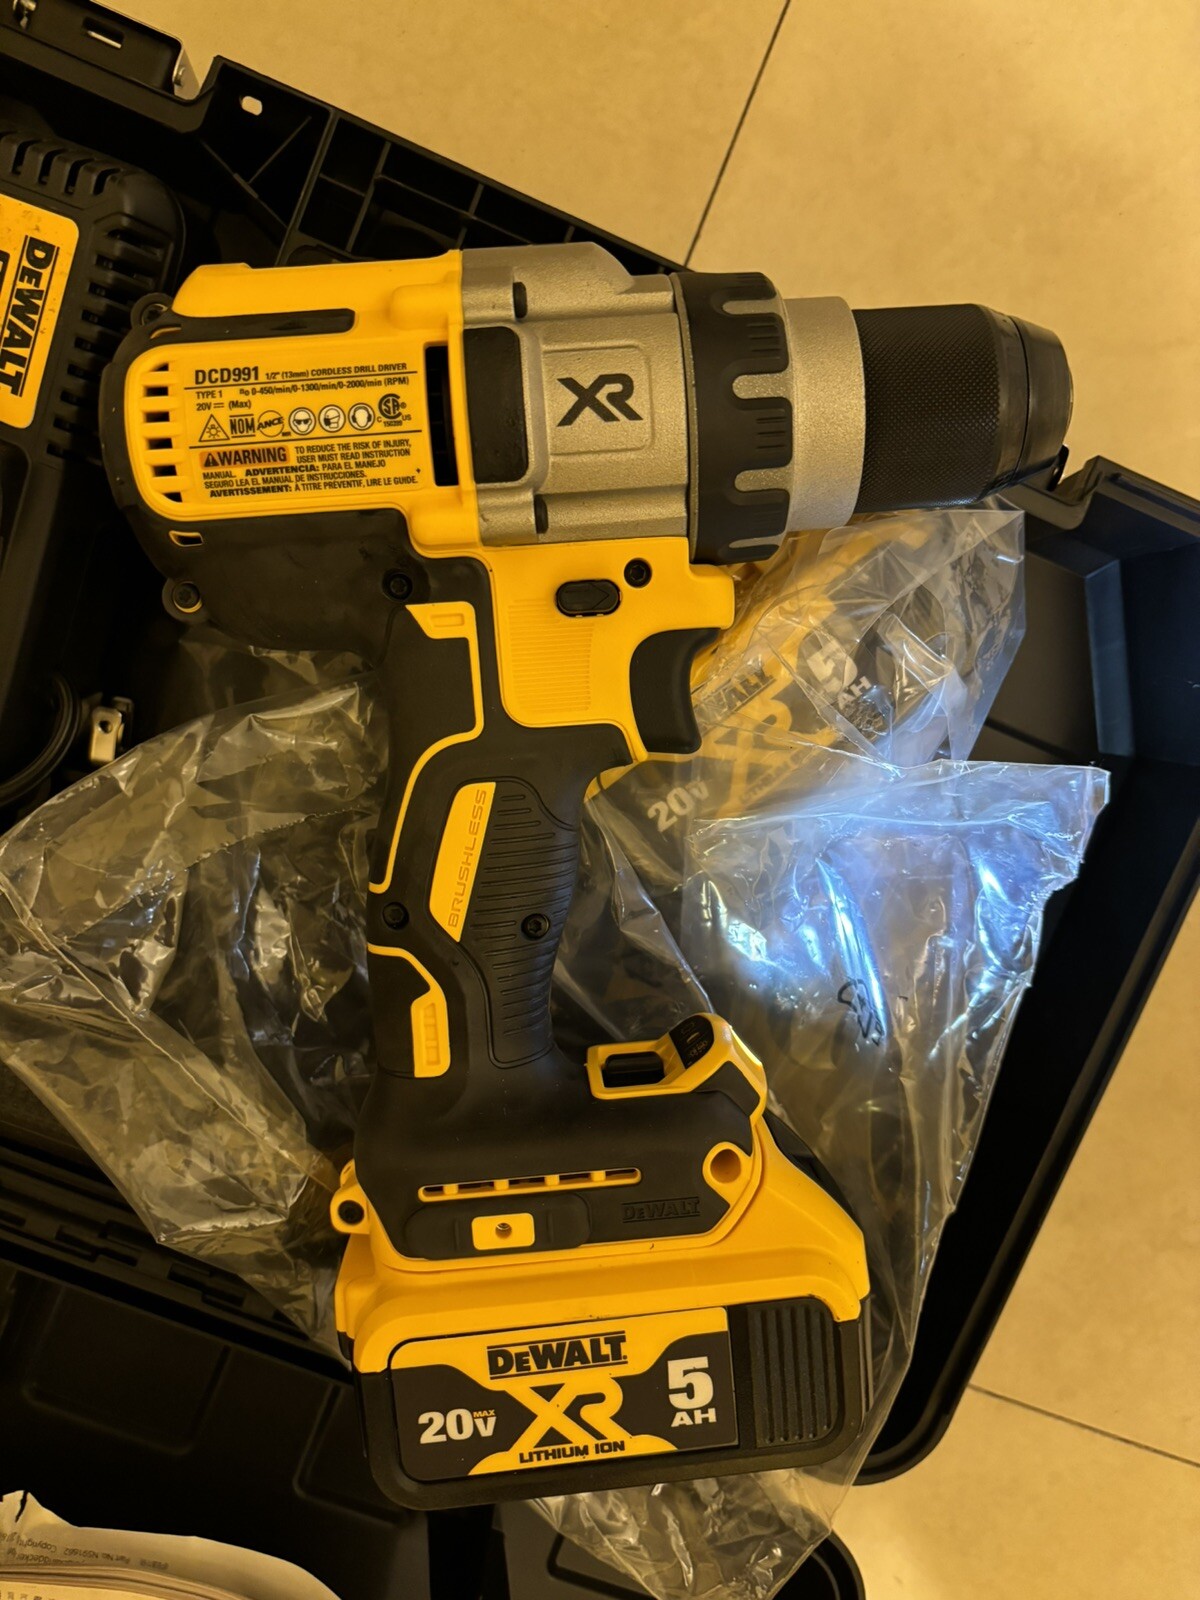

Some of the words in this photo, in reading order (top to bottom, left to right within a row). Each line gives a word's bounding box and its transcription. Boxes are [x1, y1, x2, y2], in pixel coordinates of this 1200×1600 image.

[195, 366, 259, 385] DCD991
[281, 369, 310, 380] (13mm)
[311, 366, 352, 377] CORDLESS
[354, 365, 376, 374] DRILL
[377, 362, 407, 372] DRIVER
[384, 377, 409, 388] (RPM)
[195, 390, 217, 399] TYPE
[218, 390, 223, 398] 1
[556, 373, 644, 427] XR
[196, 403, 212, 411] 20V
[228, 400, 252, 410] (Max)
[230, 416, 256, 435] NOM
[256, 416, 284, 431] ANCE
[401, 414, 412, 422] US
[218, 447, 287, 466] WARNING
[295, 446, 305, 454] TO
[306, 444, 336, 454] REDUCE
[337, 443, 352, 451] THE
[353, 442, 371, 450] RISK
[383, 439, 412, 448] INJURY,
[296, 455, 315, 464] USER
[318, 453, 338, 462] MUST
[340, 451, 361, 461] READ
[362, 448, 410, 460] INSTRUCTION
[202, 471, 236, 480] MANUAL.
[245, 463, 320, 477] ADVERTENCIA:
[321, 462, 342, 471] PARA
[344, 461, 353, 469] EL
[354, 459, 386, 468] MANEJO
[204, 480, 233, 489] SEGURO
[235, 478, 250, 487] LEA
[251, 477, 261, 485] EL
[262, 475, 294, 485] MANUAL
[295, 474, 305, 483] DE
[307, 470, 367, 482] INSTRUCCIONES.
[209, 484, 293, 498] AVERTISSEMENT:
[301, 481, 323, 490] TITRE
[366, 478, 382, 487] LIRE
[383, 477, 392, 485] LE
[393, 475, 418, 485] GUIDE.
[837, 675, 872, 711] AH
[447, 789, 487, 928] BRUSHLESS
[622, 1199, 701, 1222] DEWALT
[488, 1335, 628, 1377] DEWALT
[667, 1356, 714, 1410] 5
[503, 1379, 634, 1450] XR
[670, 1407, 717, 1428] AH
[417, 1408, 497, 1445] 20V
[473, 1409, 496, 1419] MAX
[519, 1443, 589, 1464] LITHIUM
[594, 1440, 626, 1457] ION
[115, 1554, 130, 1564] Part
